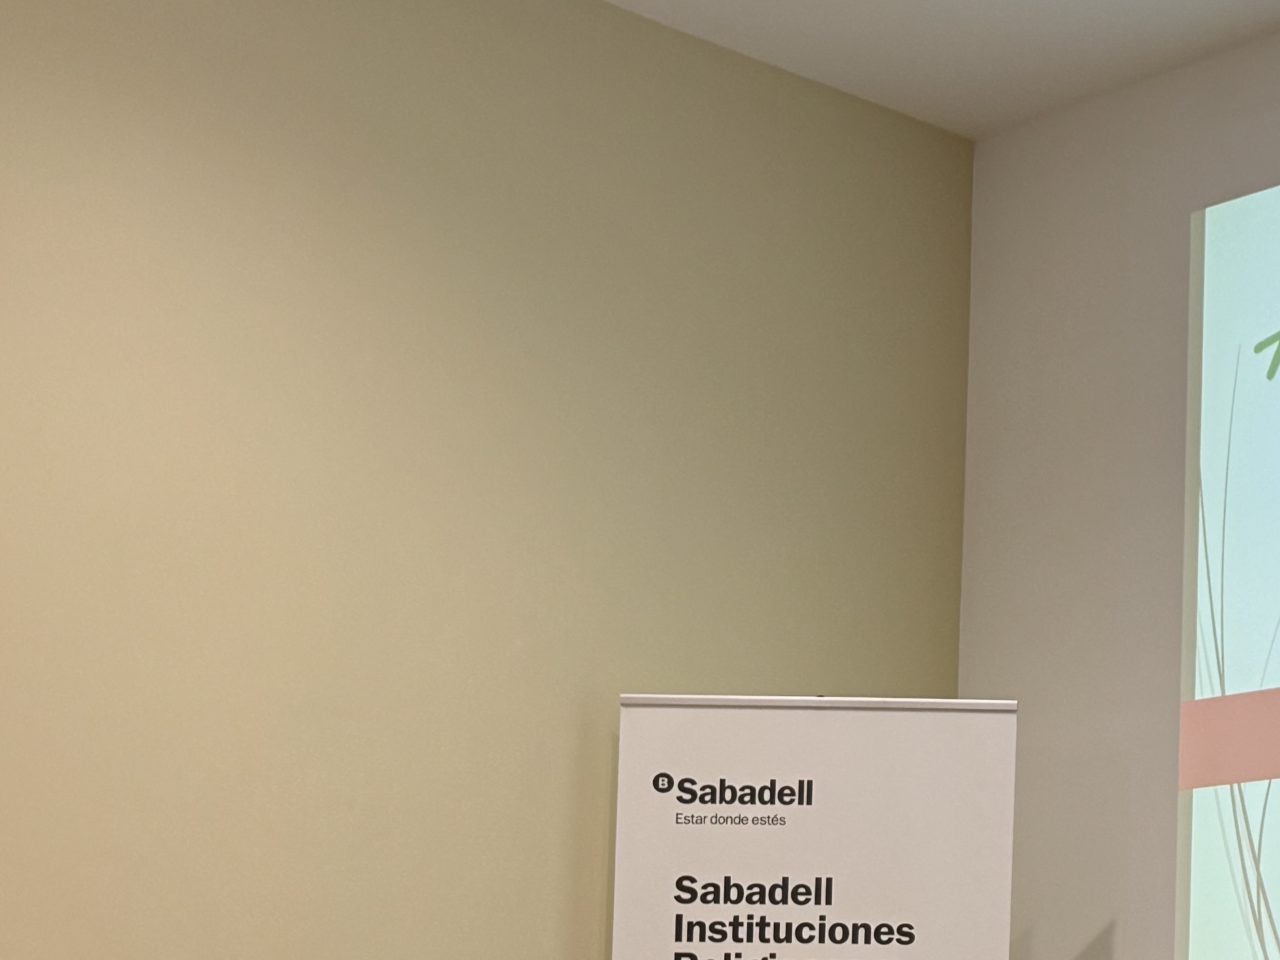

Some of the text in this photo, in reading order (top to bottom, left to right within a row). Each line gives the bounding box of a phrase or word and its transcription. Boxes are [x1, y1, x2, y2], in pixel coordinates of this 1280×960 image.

[675, 778, 813, 806] Sabadell
[675, 813, 787, 826] Estar donde estés
[673, 875, 833, 906] Sabadell
[673, 914, 916, 946] Instituciones
